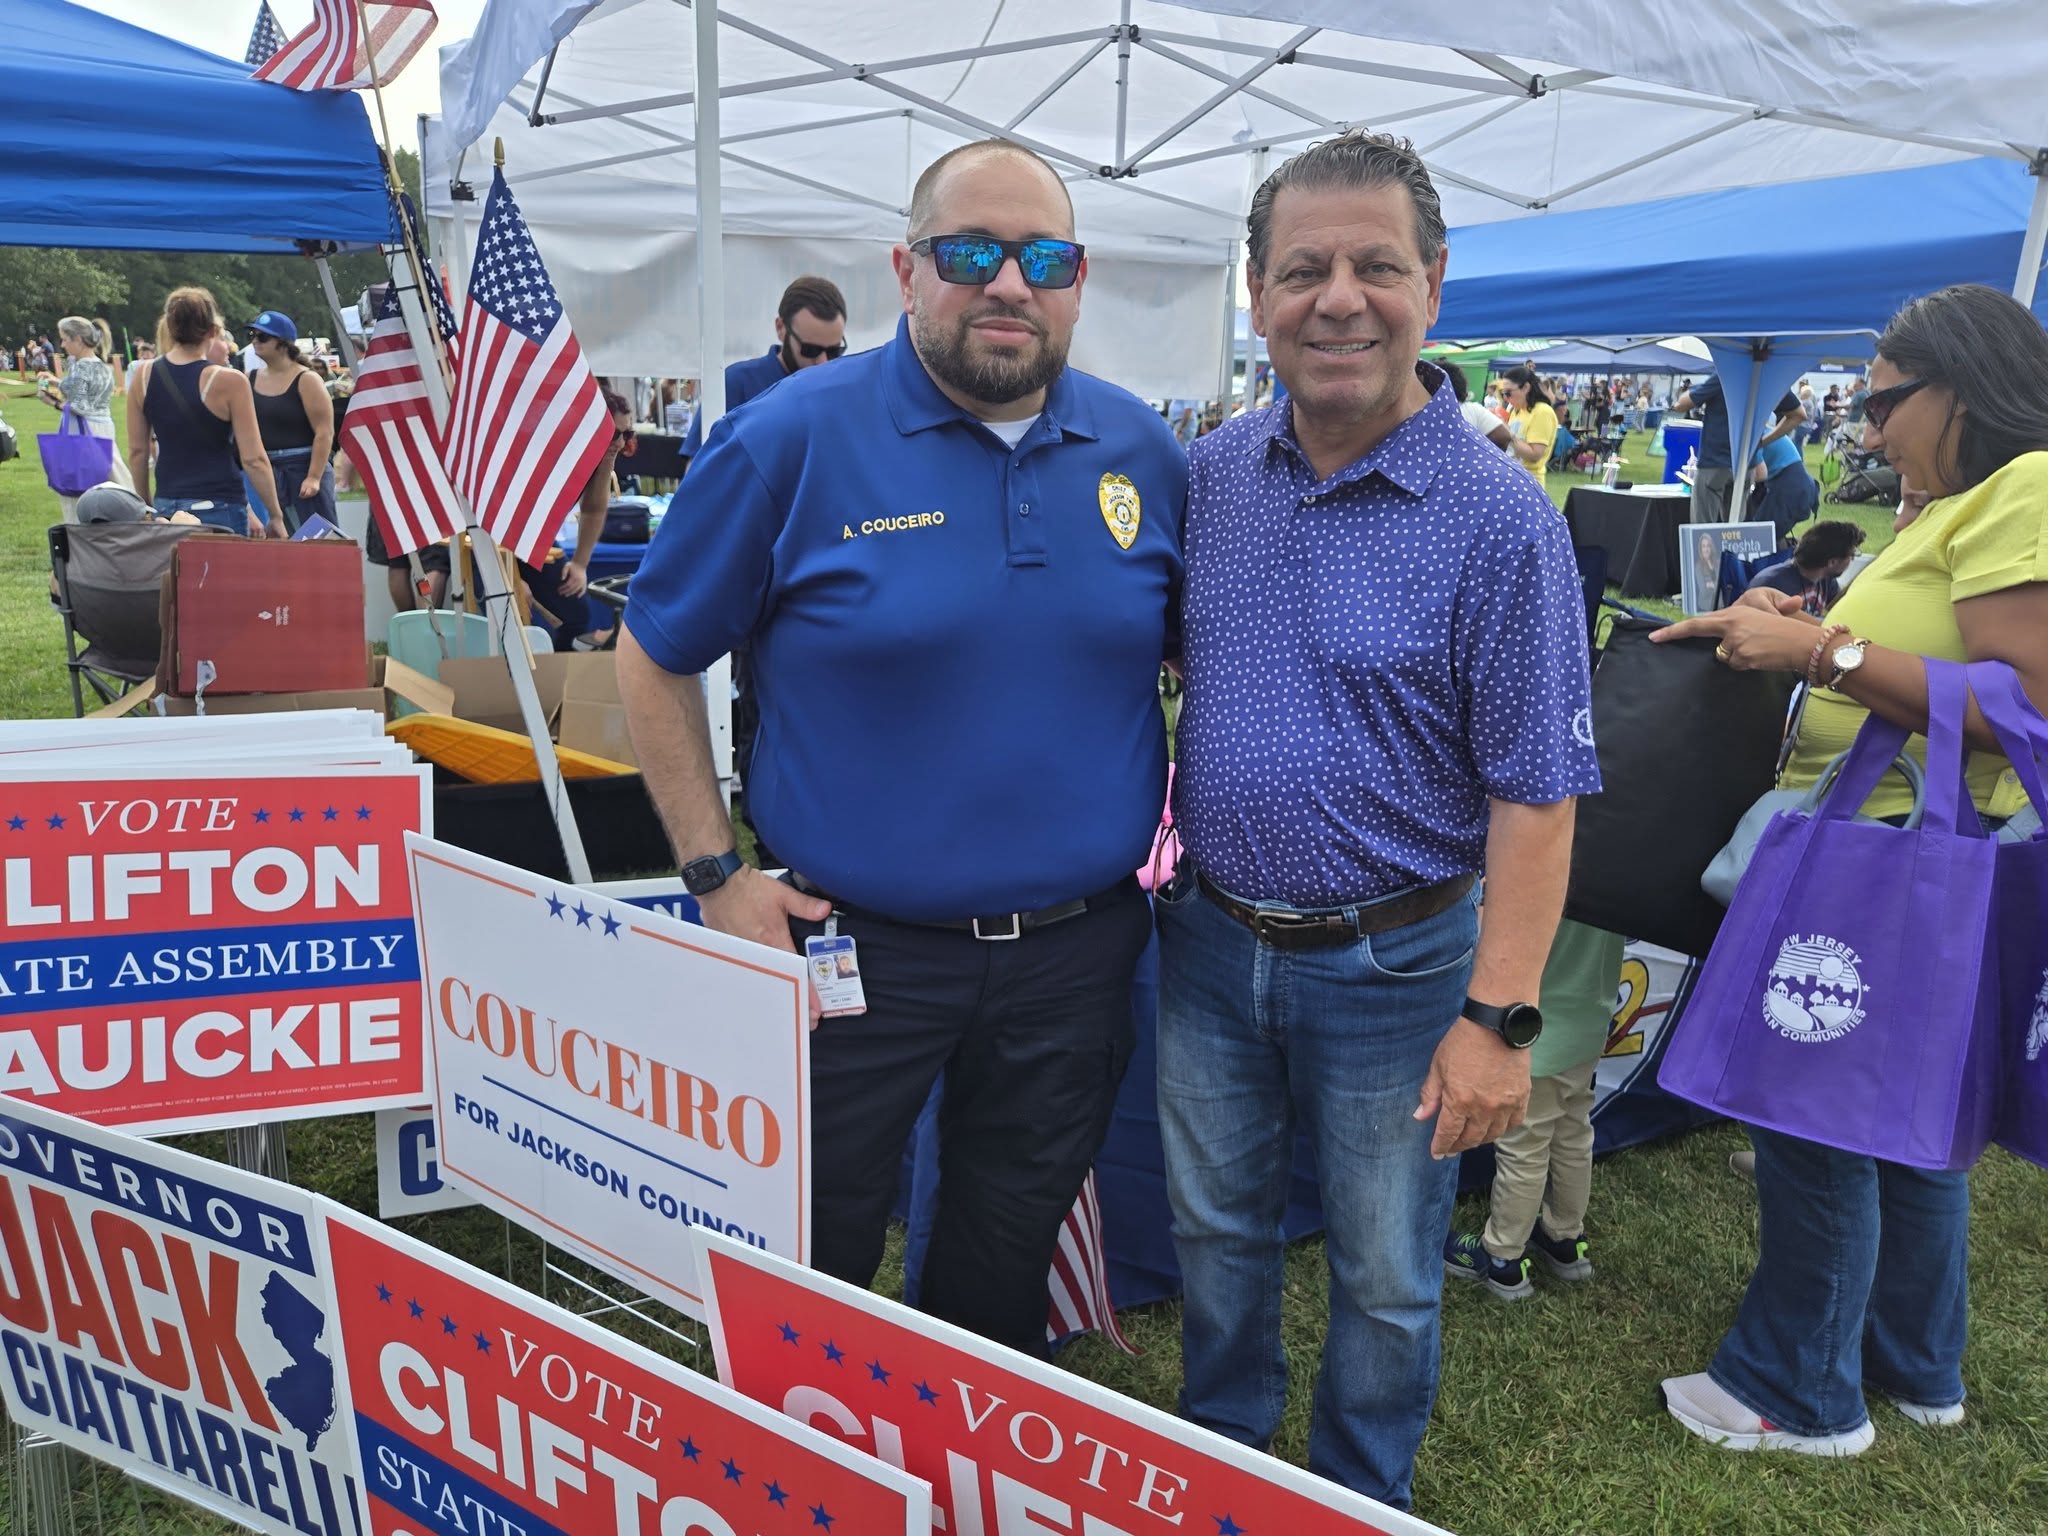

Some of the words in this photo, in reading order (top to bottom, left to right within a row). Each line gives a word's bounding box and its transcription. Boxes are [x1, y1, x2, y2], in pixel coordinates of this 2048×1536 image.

[843, 525, 857, 539] A.
[861, 511, 944, 534] COUCEIRO
[1721, 531, 1741, 540] VOTE
[78, 798, 239, 835] VOTE
[109, 935, 403, 988] ASSEMBLY
[1807, 934, 1863, 965] JERSEY
[1780, 1008, 1867, 1043] COMMUNITIES
[439, 977, 781, 1169] COUCEIRO
[455, 1093, 499, 1135] FOR
[507, 1123, 629, 1199] JACKSON
[0, 1175, 282, 1434] JACK
[500, 1328, 663, 1450] VOTE
[951, 1378, 1189, 1526] VOTE
